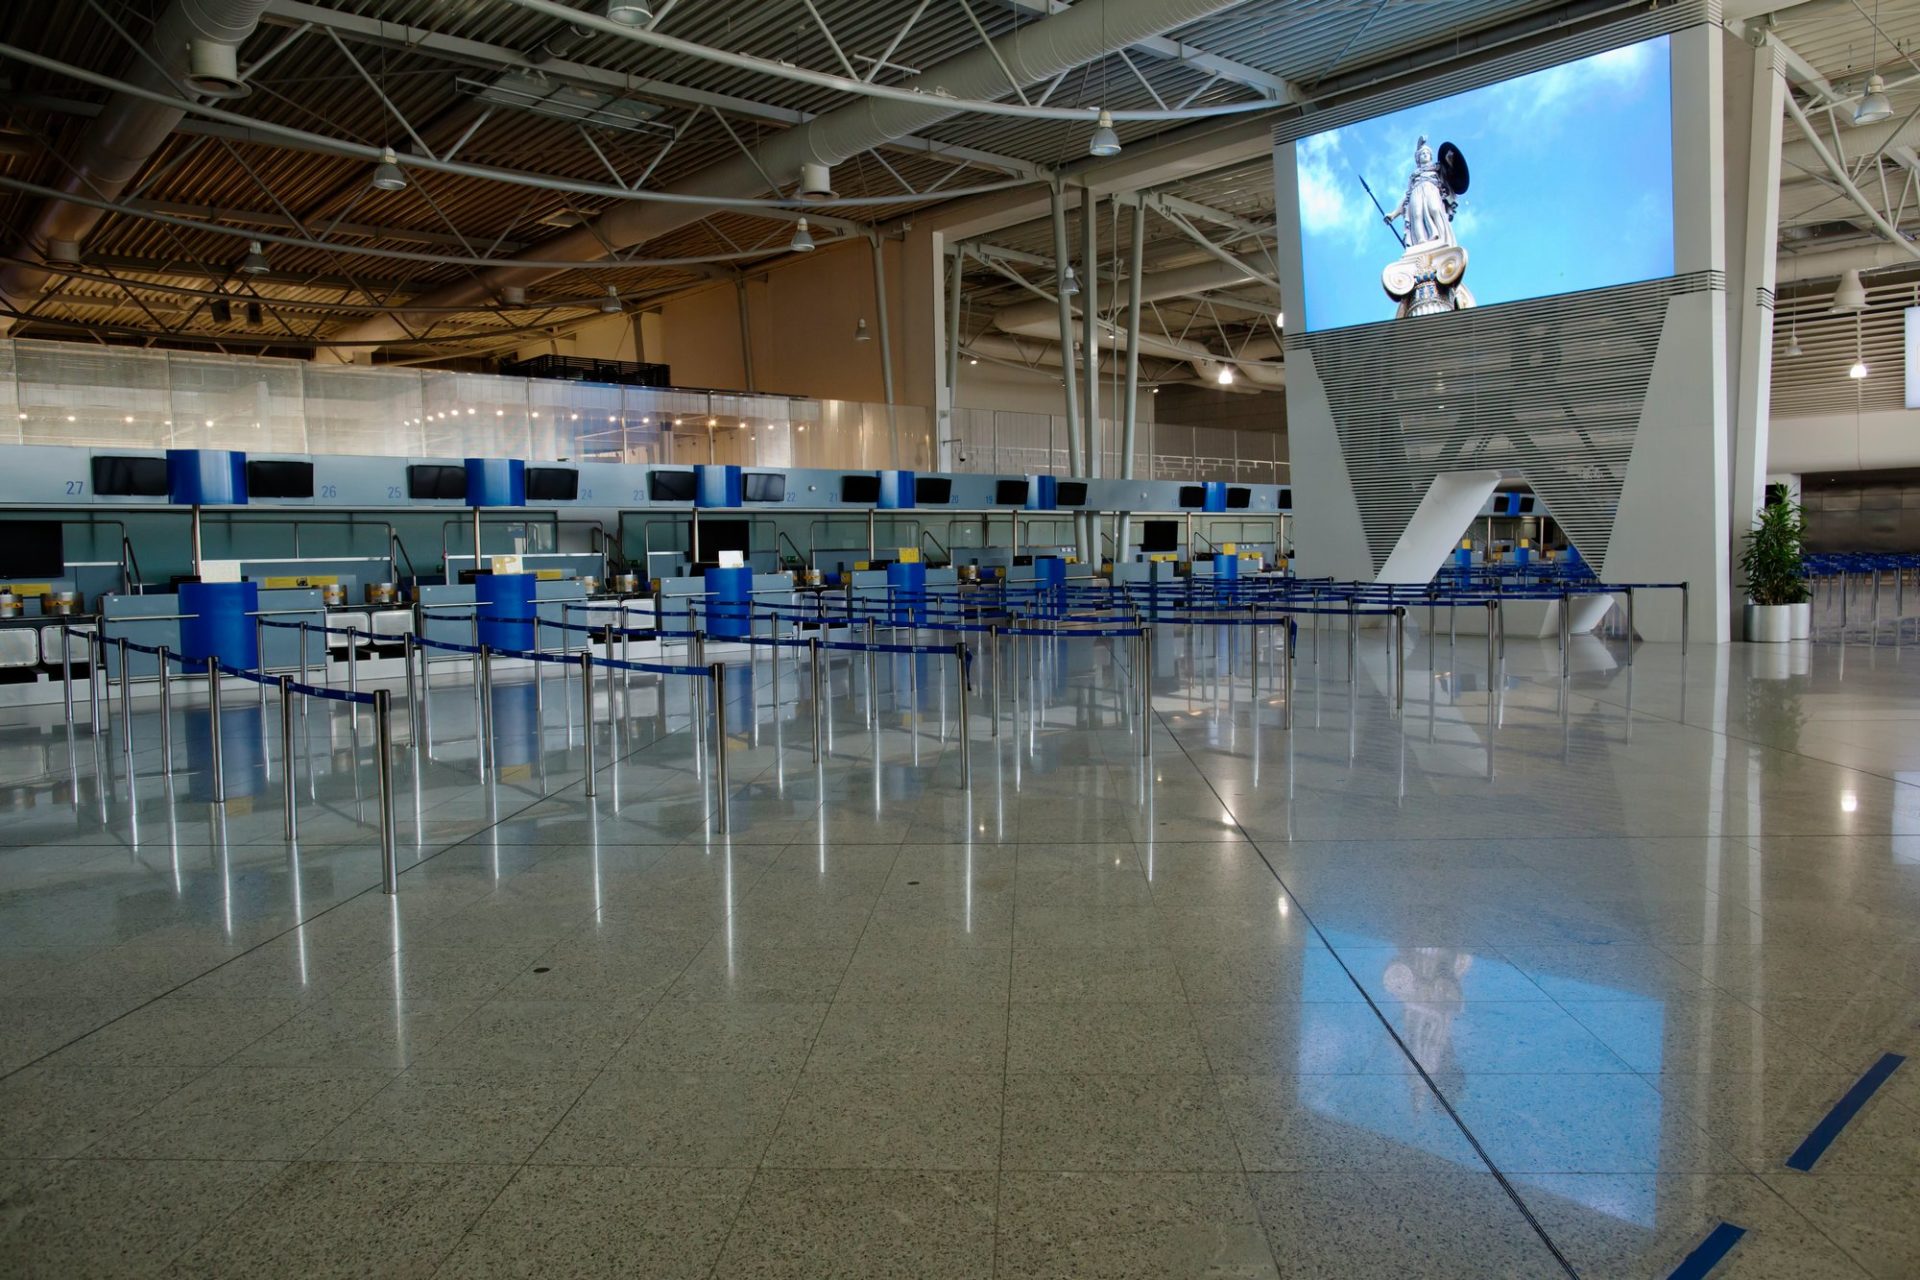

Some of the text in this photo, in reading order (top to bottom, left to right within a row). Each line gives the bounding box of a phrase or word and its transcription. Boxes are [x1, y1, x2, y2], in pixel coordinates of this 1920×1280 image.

[66, 481, 83, 495] 27
[321, 485, 337, 498] 26
[387, 486, 402, 499] 25
[581, 489, 593, 500] 24
[633, 490, 645, 501] 23
[787, 492, 796, 502] 22
[830, 492, 838, 502] 21
